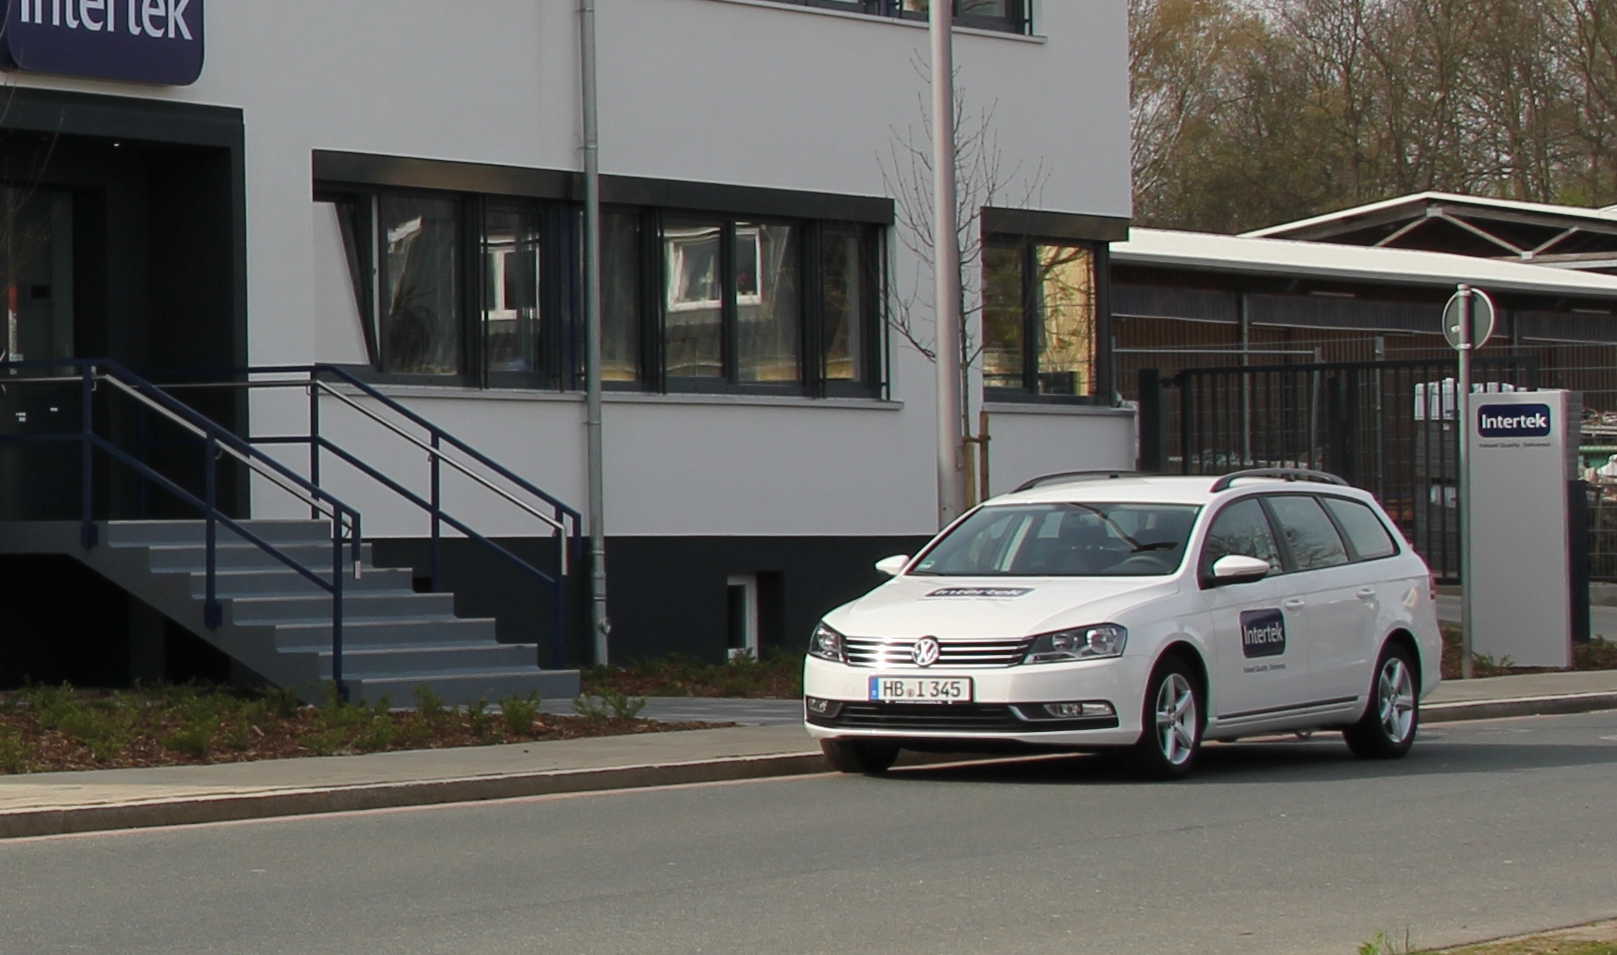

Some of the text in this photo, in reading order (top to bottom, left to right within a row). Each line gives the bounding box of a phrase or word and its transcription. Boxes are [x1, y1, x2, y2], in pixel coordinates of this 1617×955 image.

[1481, 413, 1547, 429] Intertek
[1243, 622, 1284, 645] Intertek
[883, 681, 961, 697] HB I 345
